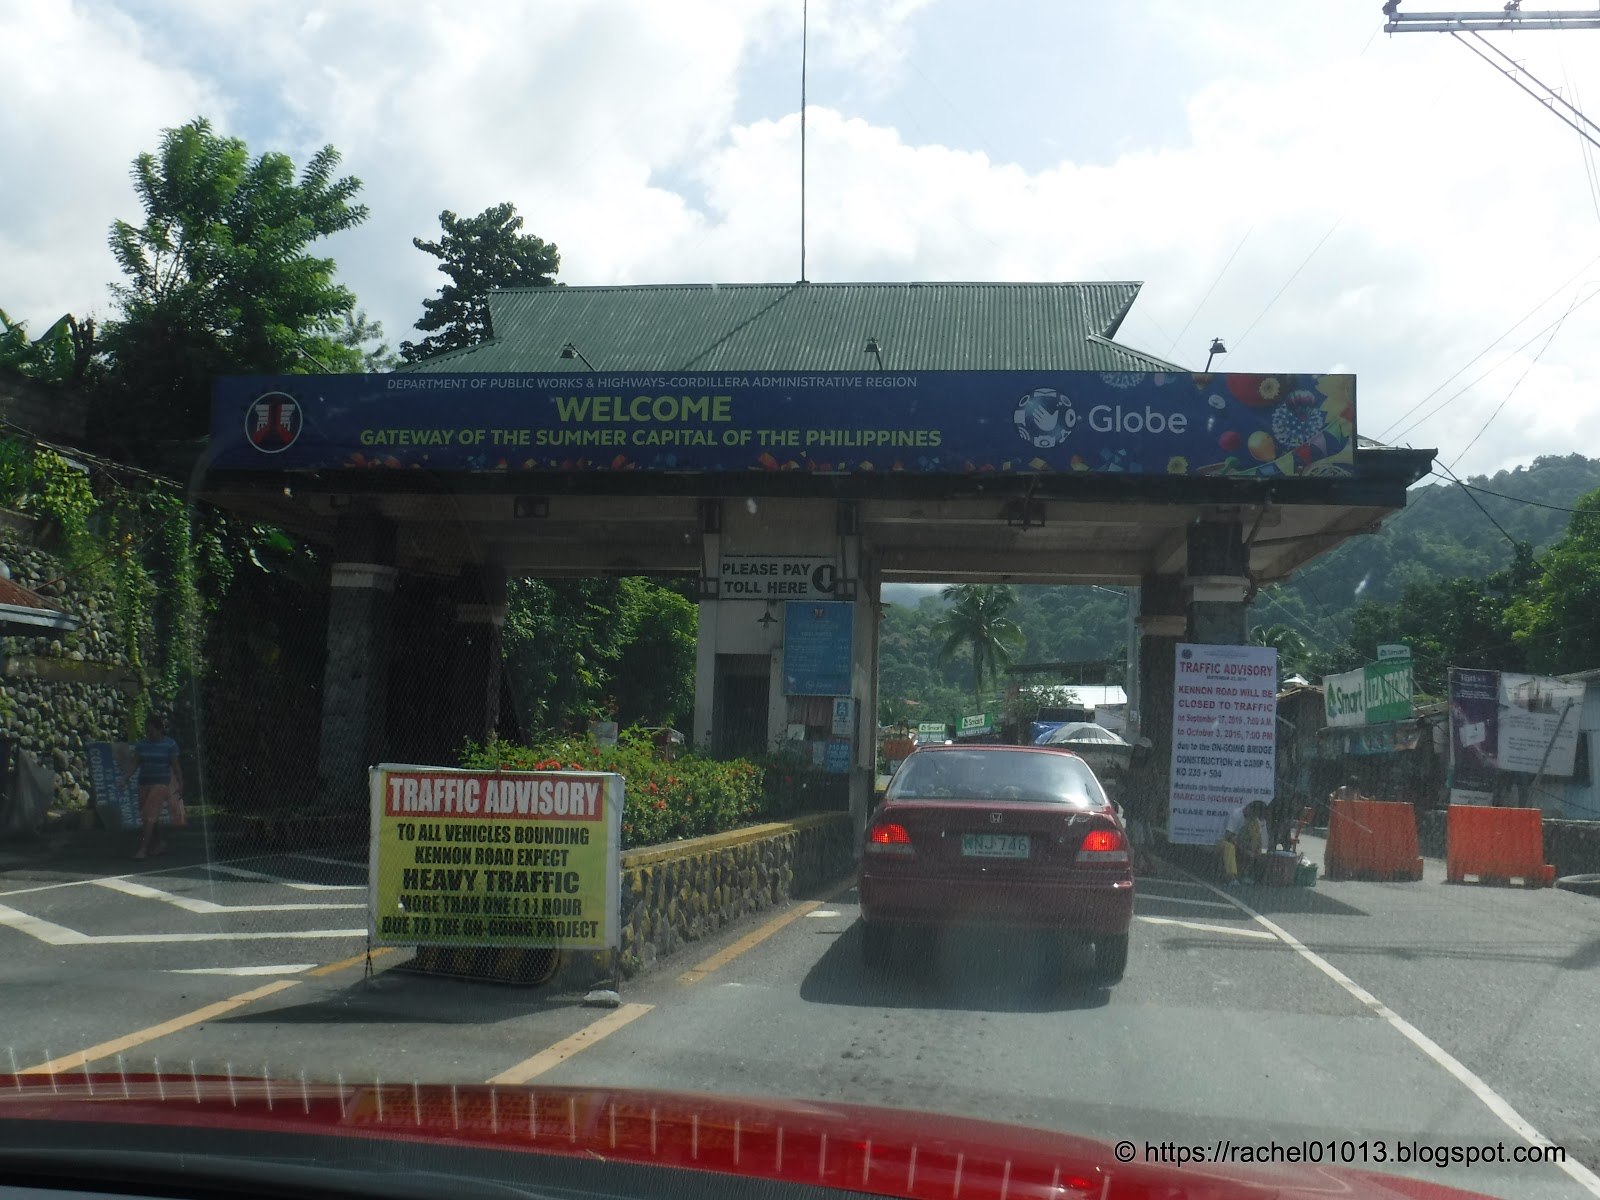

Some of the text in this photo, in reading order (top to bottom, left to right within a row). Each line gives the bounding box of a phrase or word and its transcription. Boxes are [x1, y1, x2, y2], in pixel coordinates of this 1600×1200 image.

[387, 376, 917, 389] DEPARTMENT OF PUBLIC WORKS & HIGHWAYS-CORDILLERA ADMINISTRATIVE REGION
[555, 396, 732, 422] WELCOME
[1088, 404, 1188, 434] Globe
[360, 429, 942, 446] GATEWAY OF THE SUMMER CAPITAL OF THE PHILIPPINES
[722, 564, 811, 576] PLEASE PAY
[724, 581, 808, 594] TOLL HERE
[1180, 662, 1273, 677] TRAFFIC ADVISORY
[1178, 686, 1273, 698] KENNON ROAD WILL BE
[1178, 700, 1273, 712] CLOSED TO TRAFFIC
[1186, 714, 1217, 724] September
[1178, 728, 1184, 736] to
[1186, 728, 1214, 736] October
[1246, 730, 1260, 740] 7:00
[1262, 732, 1273, 740] PM
[1199, 742, 1210, 751] the
[1246, 744, 1272, 754] BRIDGE
[1176, 755, 1232, 766] CONSTRUCTION
[389, 778, 600, 816] TRAFFIC ADVISORY
[1174, 792, 1244, 804] MARCOS HIGHWAY
[1172, 808, 1204, 816] PLEASE
[397, 823, 590, 845] TO ALL VEHICLES BOUNDING
[997, 836, 1028, 852] 746
[415, 846, 569, 866] KENNON ROAD EXPECT
[403, 868, 580, 894] HEAVY TRAFFIC
[400, 895, 440, 912] MORE
[442, 896, 480, 914] THAN
[483, 896, 512, 914] ONE
[542, 898, 582, 916] HOUR
[382, 916, 410, 934] DUE
[412, 917, 430, 934] TO
[434, 918, 460, 935] THE
[536, 920, 598, 938] PROJECT
